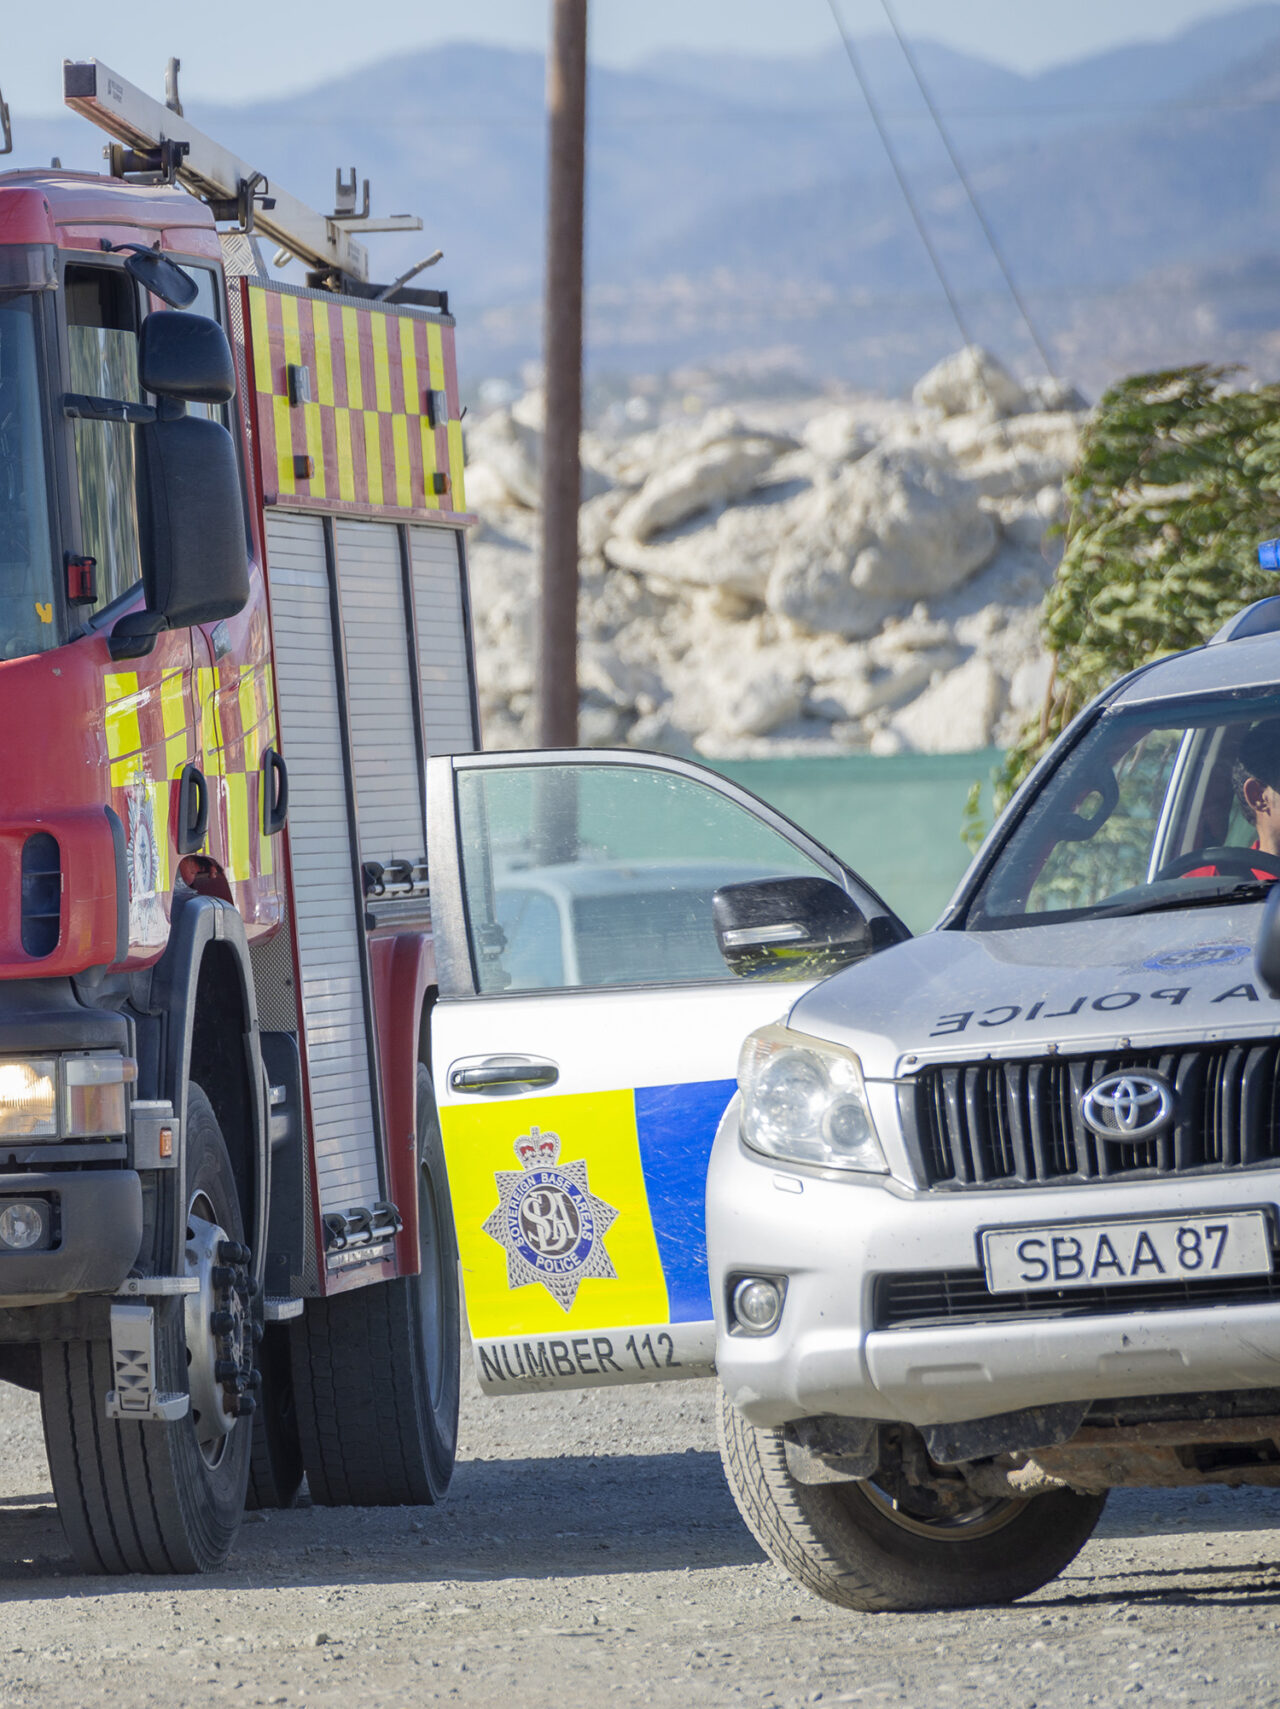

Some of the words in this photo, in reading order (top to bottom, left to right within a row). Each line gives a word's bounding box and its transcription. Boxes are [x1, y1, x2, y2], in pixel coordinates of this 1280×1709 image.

[508, 1175, 537, 1247] SOVEREIGN
[541, 1172, 572, 1192] BASE
[572, 1194, 593, 1241] AREAS
[535, 1252, 582, 1272] POLICE
[1017, 1231, 1166, 1282] SBAA
[1176, 1224, 1229, 1271] 87
[478, 1337, 623, 1381] NUMBER
[625, 1332, 682, 1370] 112
